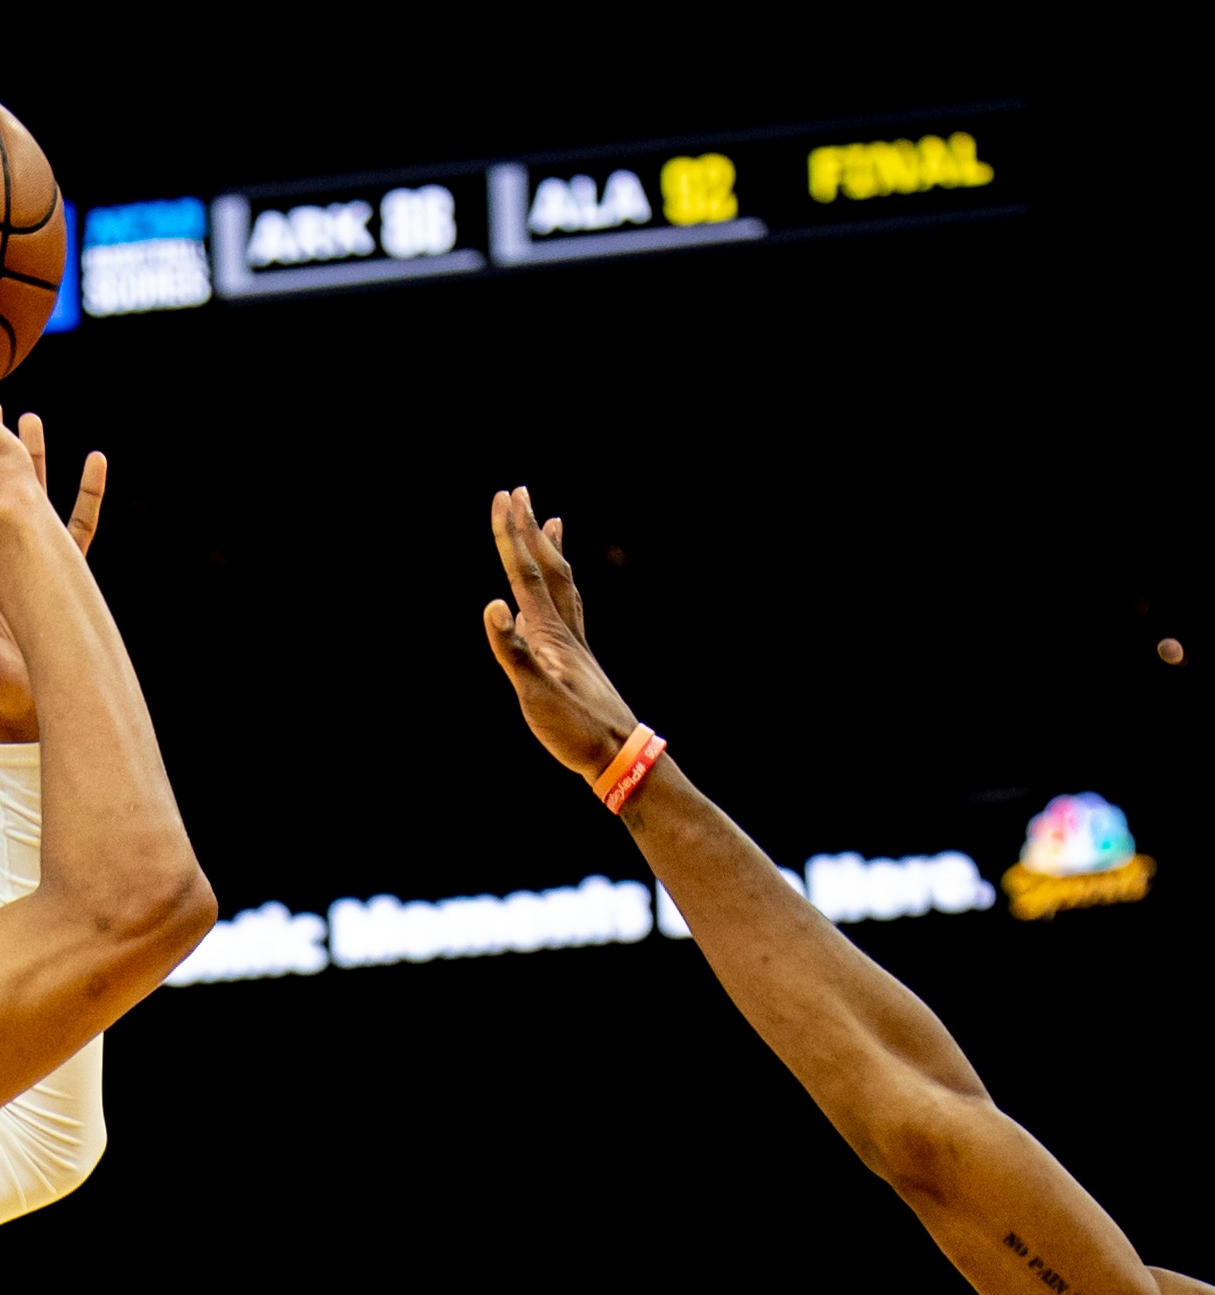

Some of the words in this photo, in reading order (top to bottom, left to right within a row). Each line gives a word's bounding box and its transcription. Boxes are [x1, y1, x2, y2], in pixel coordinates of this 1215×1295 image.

[809, 134, 992, 200] FINAL
[245, 202, 374, 265] ARK
[529, 170, 652, 234] ALA
[1002, 1231, 1029, 1258] NO
[1027, 1256, 1069, 1295] PAIN
